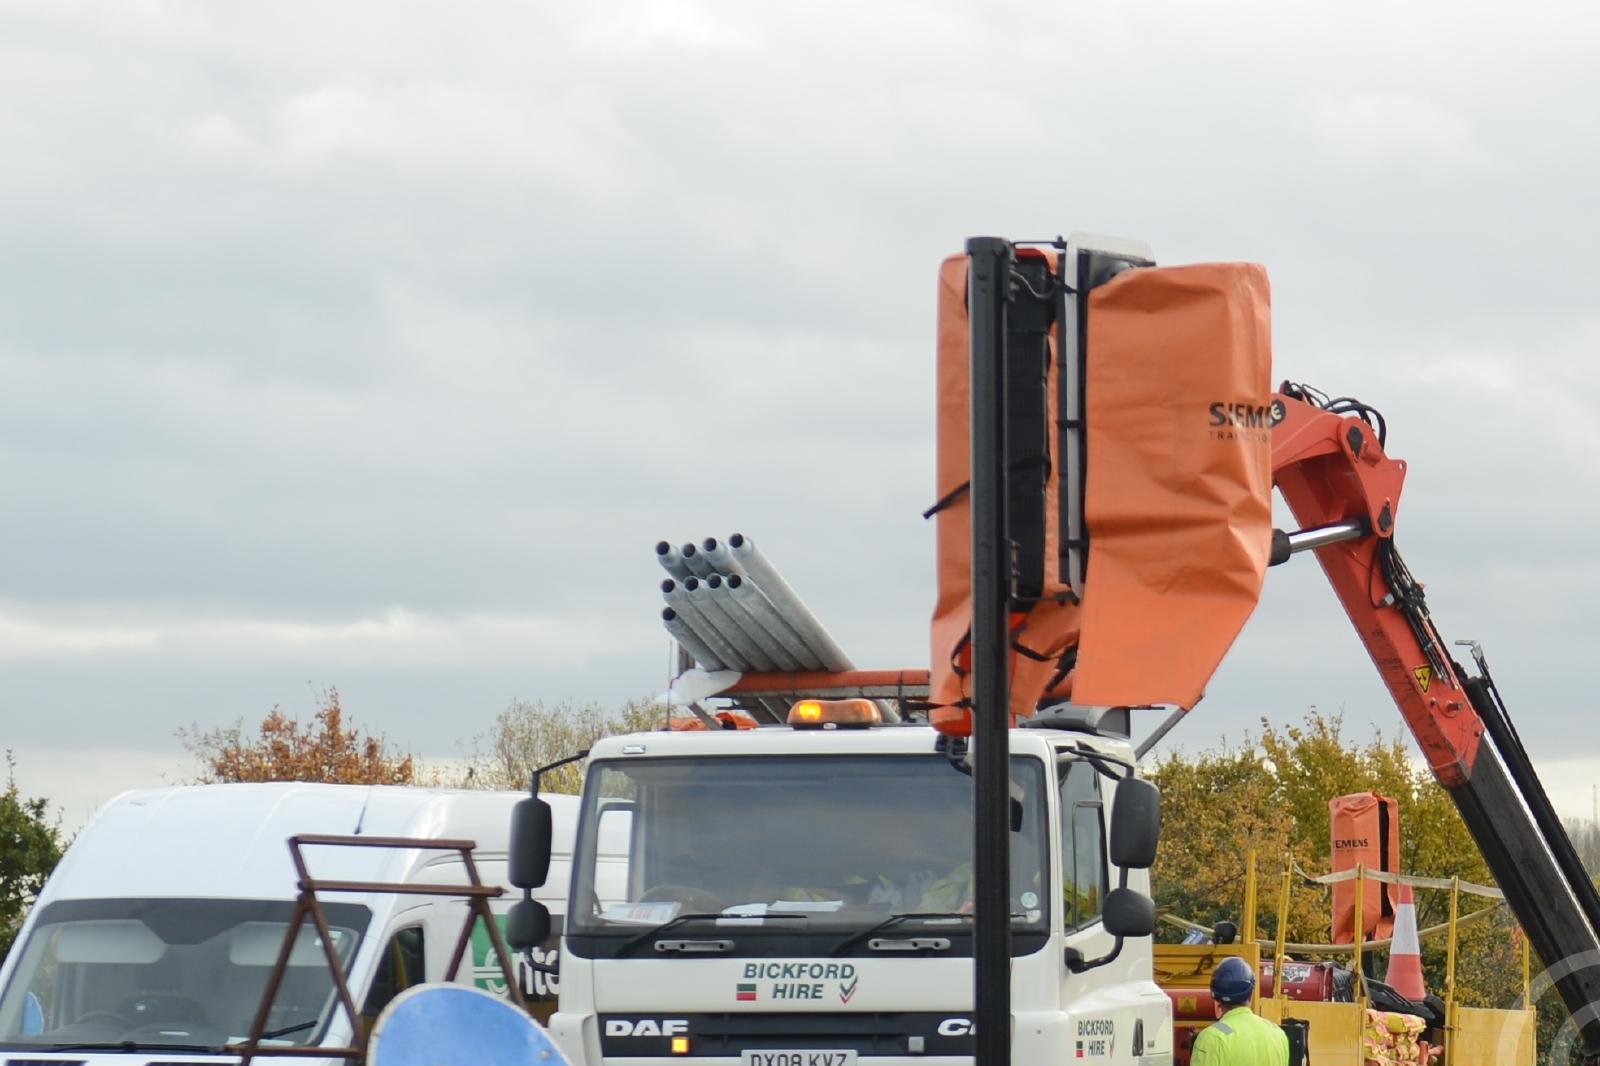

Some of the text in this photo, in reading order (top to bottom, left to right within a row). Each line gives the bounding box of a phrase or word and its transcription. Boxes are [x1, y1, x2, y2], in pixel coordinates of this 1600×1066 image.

[744, 963, 856, 980] BICKFORD
[772, 983, 824, 999] HIRE
[606, 1019, 689, 1037] DAF
[1078, 1020, 1114, 1036] BICKFORD
[1088, 1040, 1105, 1056] HIRE
